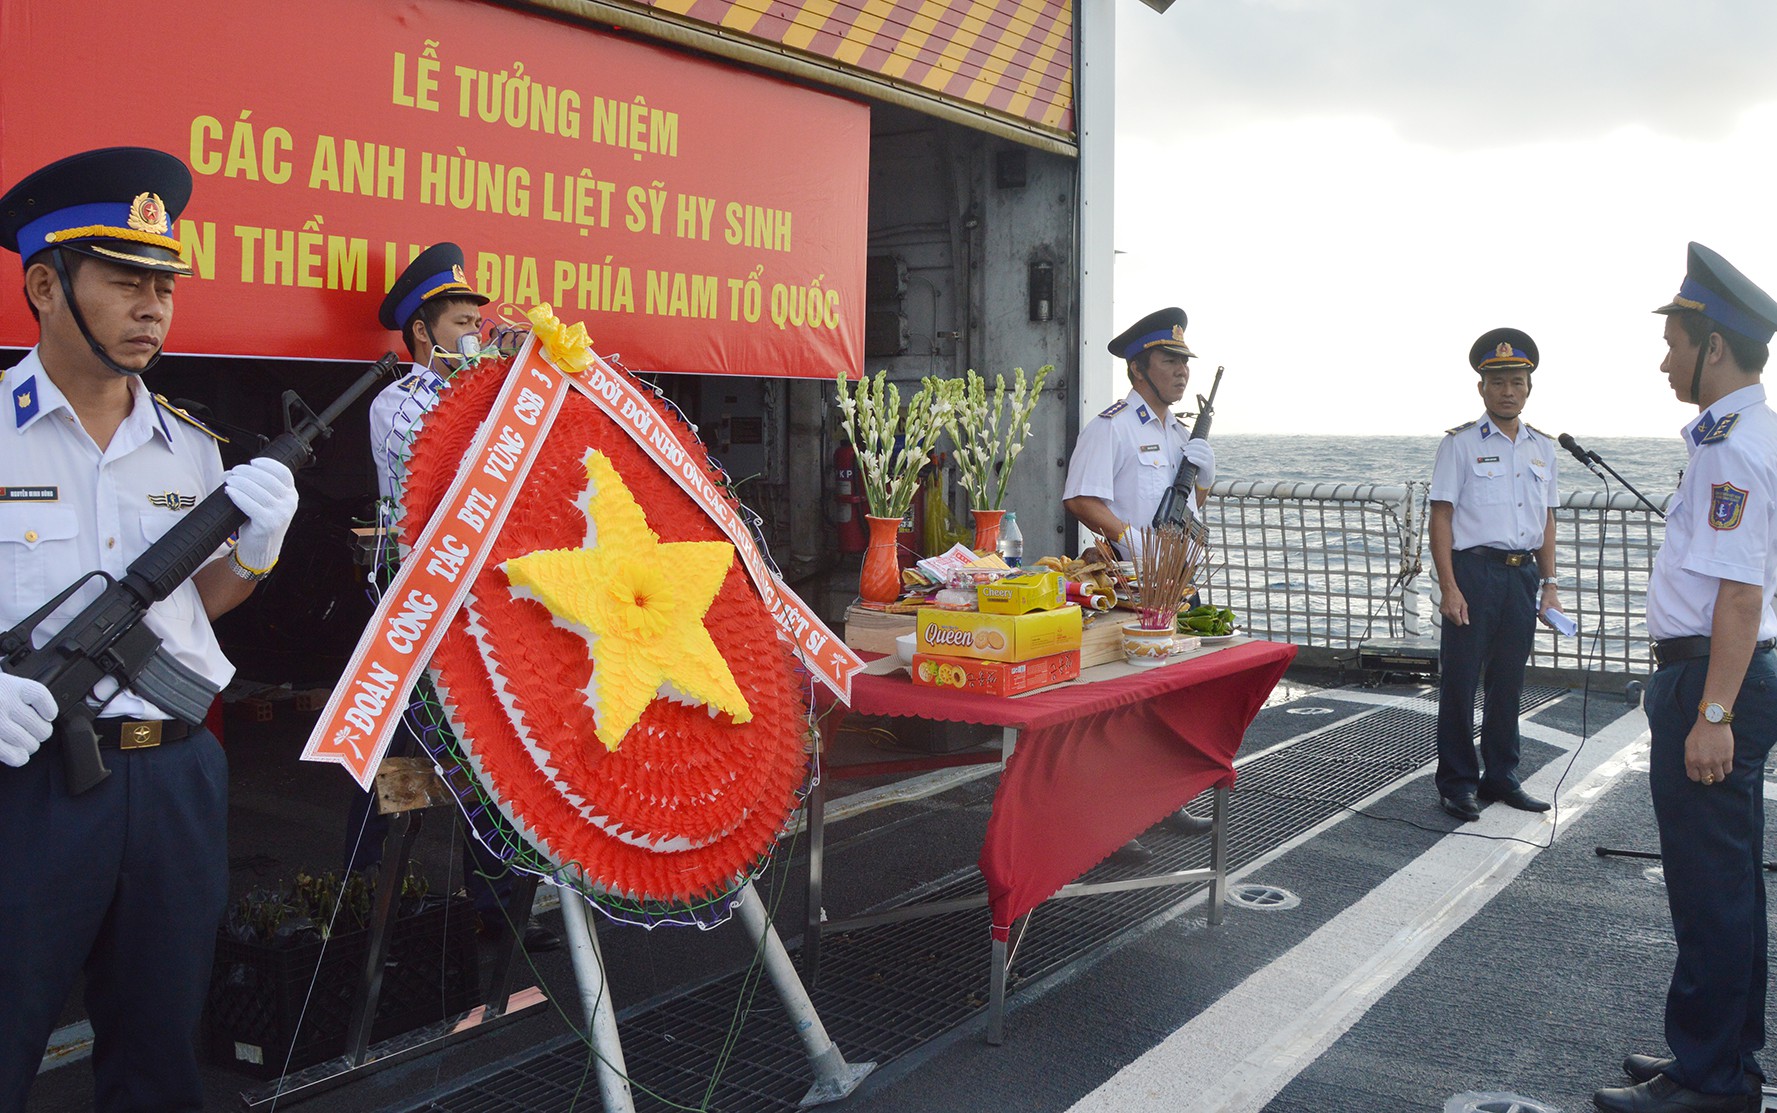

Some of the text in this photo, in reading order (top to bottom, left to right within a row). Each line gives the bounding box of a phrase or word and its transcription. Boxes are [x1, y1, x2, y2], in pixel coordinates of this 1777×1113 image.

[392, 39, 678, 161] LỄ TƯỞNG NIỆM
[190, 109, 792, 252] CÁC ANH HÙNG LIỆT SỸ HY SINH
[234, 214, 368, 292] THỀM
[476, 251, 541, 315] ĐỊA
[553, 255, 635, 313] PHÍA
[645, 269, 718, 319] NAM
[727, 264, 764, 323] TỔ
[771, 273, 839, 330] QUỐC
[588, 368, 623, 407] ĐỜI
[620, 397, 653, 435] ĐỜI
[683, 462, 704, 493] ƠN
[728, 518, 753, 559] ANH
[345, 368, 553, 736] ĐOÀN CÔNG TÁC BTL VÙNG CSB 3
[982, 587, 1013, 600] Cheery
[925, 622, 974, 647] Queen
